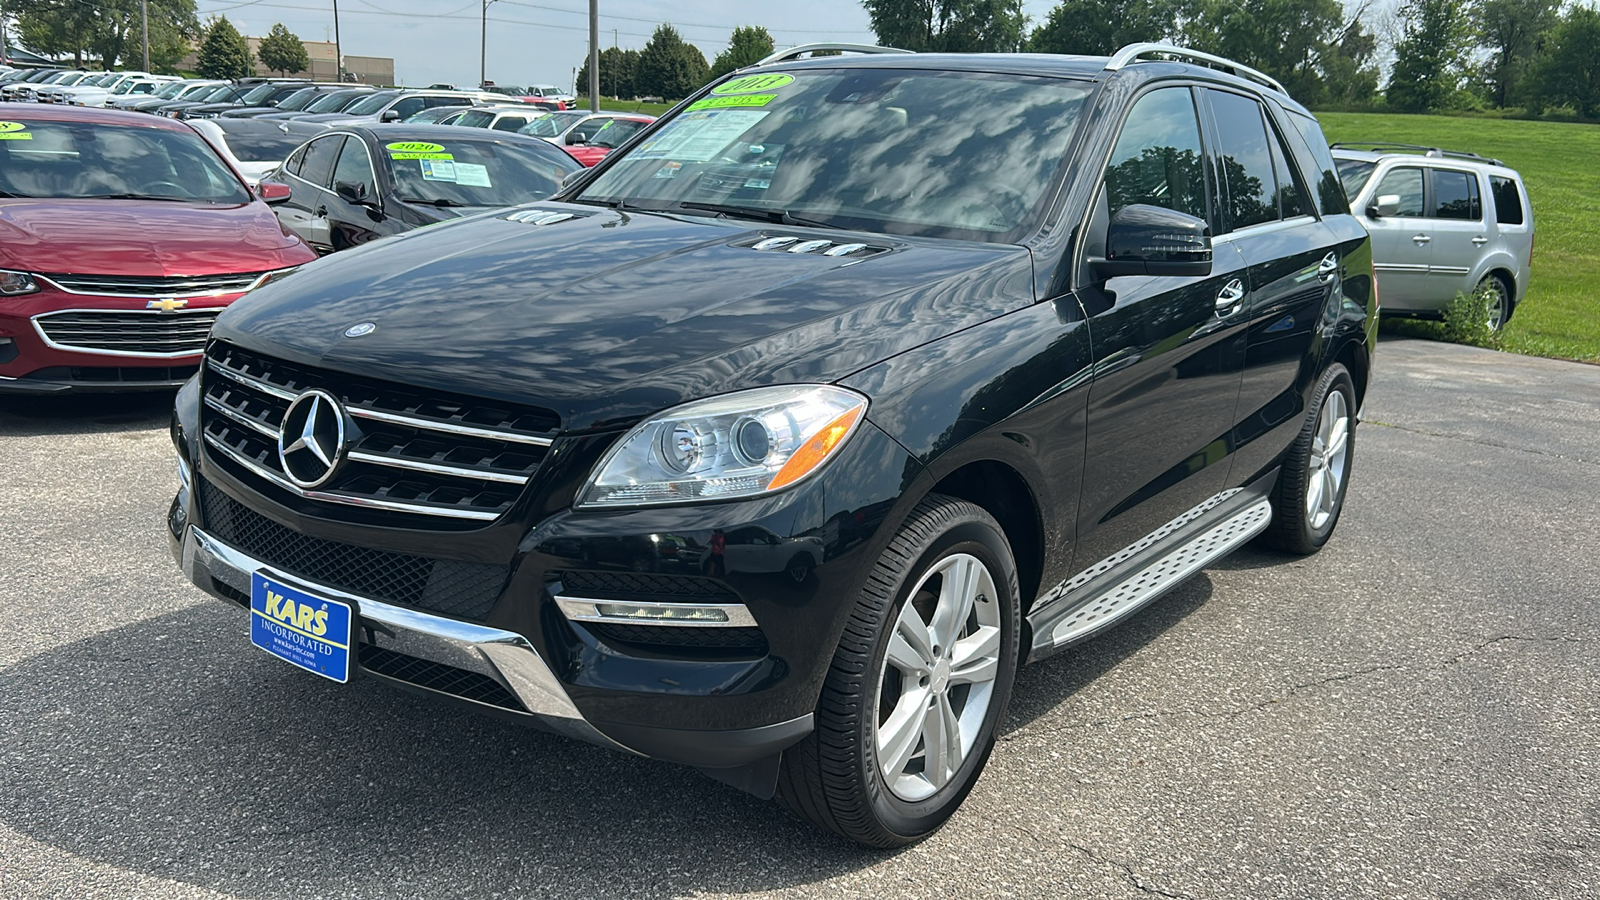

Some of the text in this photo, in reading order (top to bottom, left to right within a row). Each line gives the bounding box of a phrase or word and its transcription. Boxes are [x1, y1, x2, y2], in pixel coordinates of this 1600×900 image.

[719, 76, 785, 92] 2013
[395, 143, 435, 151] 2020
[265, 590, 328, 636] KARS
[261, 618, 333, 656] INCORPORATED
[273, 637, 315, 659] www.kars-inc.com
[272, 644, 292, 657] PLEASANT
[303, 658, 317, 668] IOWA
